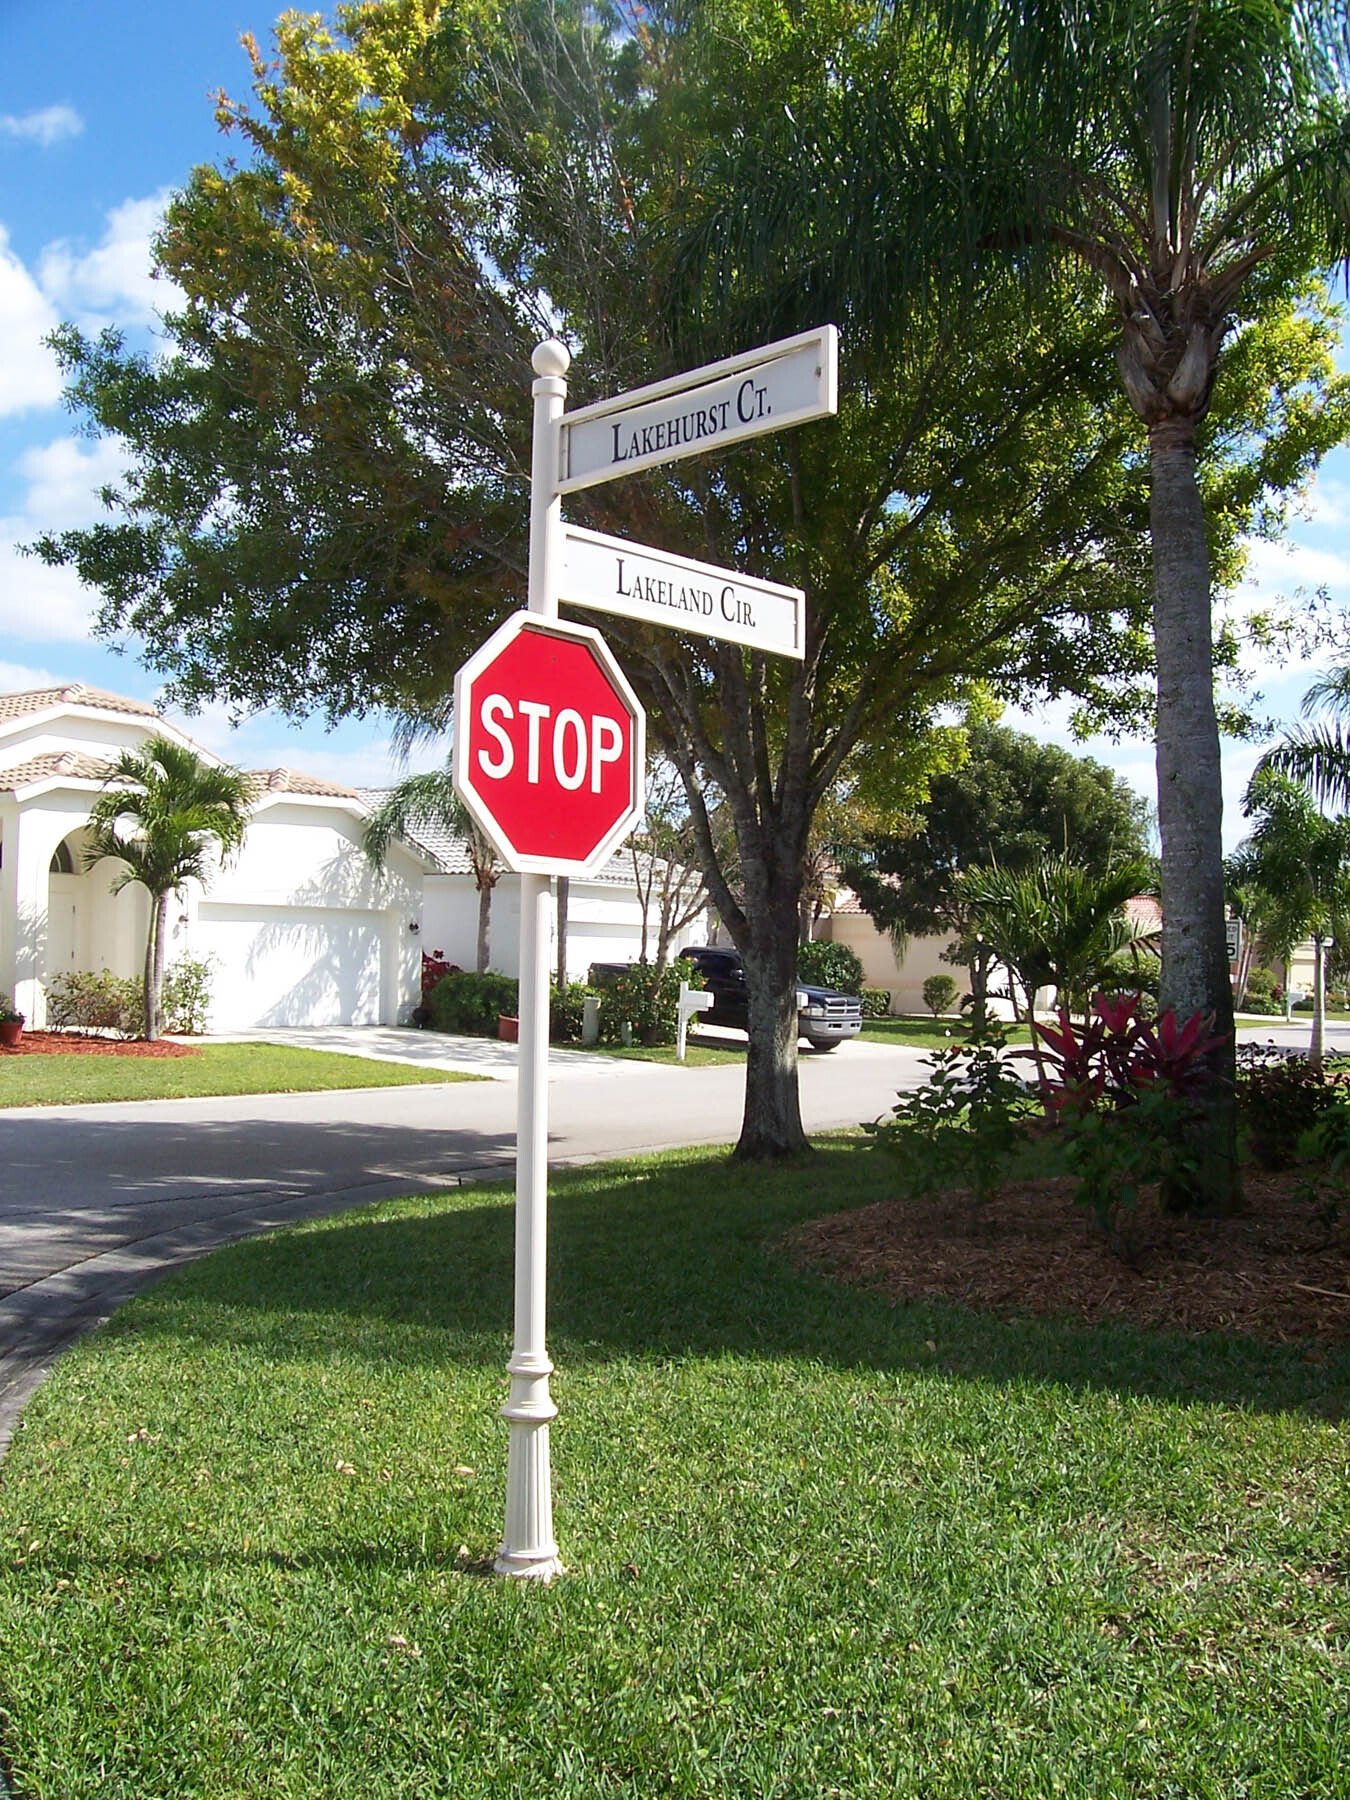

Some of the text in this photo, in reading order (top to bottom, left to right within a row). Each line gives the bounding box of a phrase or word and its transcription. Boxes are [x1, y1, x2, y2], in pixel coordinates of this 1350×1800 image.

[611, 378, 772, 463] LAKEHURST CT.
[615, 558, 756, 628] LAKELAND CIR.
[477, 693, 624, 794] STOP
